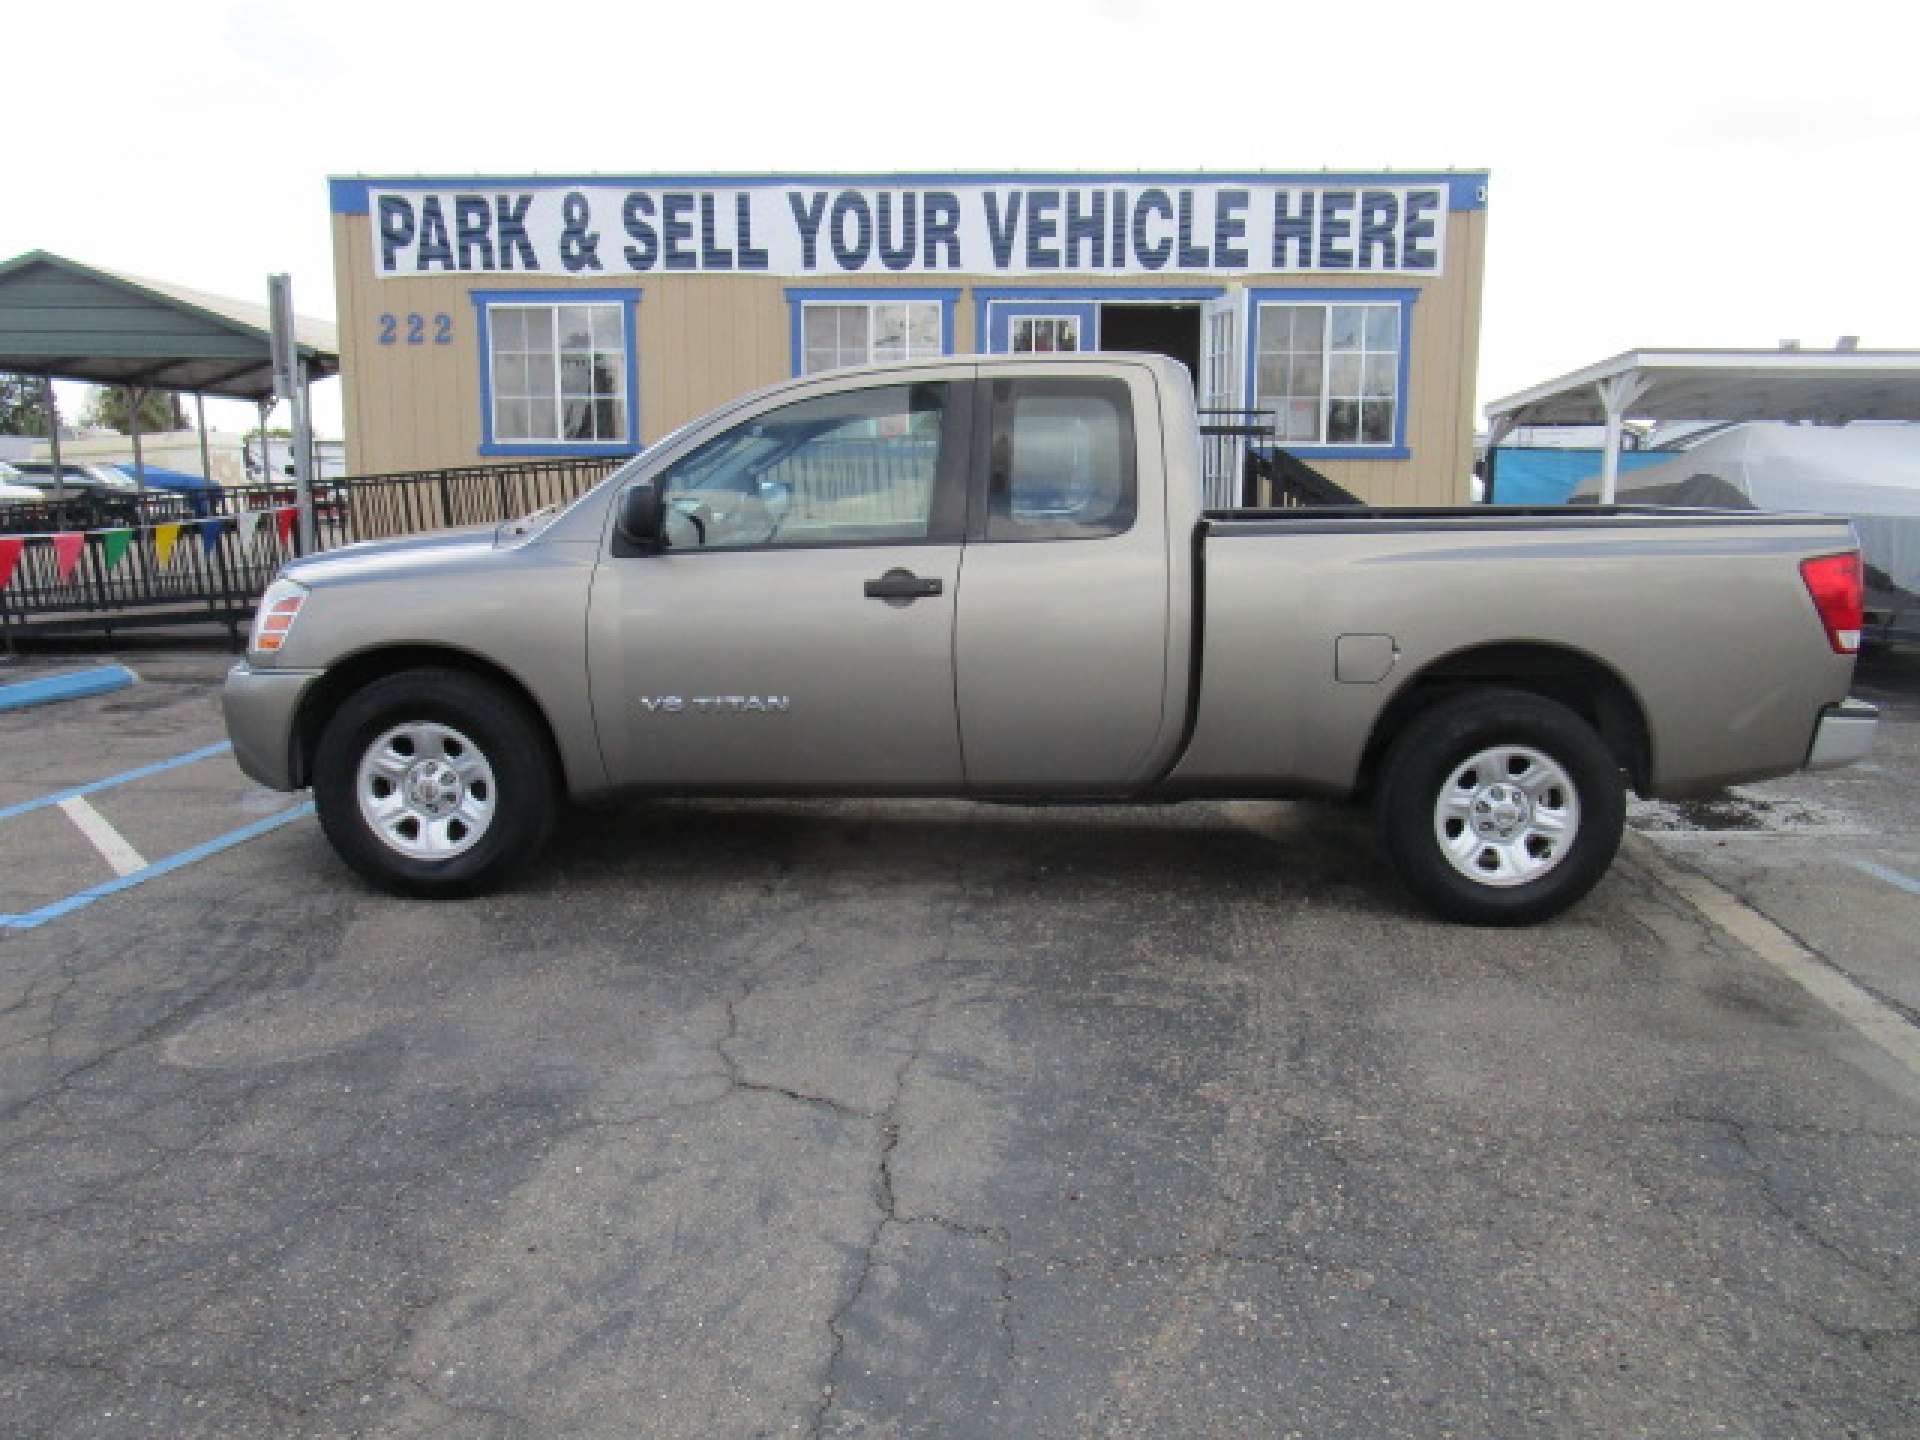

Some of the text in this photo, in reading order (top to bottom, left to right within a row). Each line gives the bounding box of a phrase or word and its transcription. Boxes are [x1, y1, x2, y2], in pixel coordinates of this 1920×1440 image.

[377, 189, 1439, 272] PARK & SELL YOUR VEHICLE HERE
[377, 312, 454, 345] 222
[692, 695, 790, 712] TITAN
